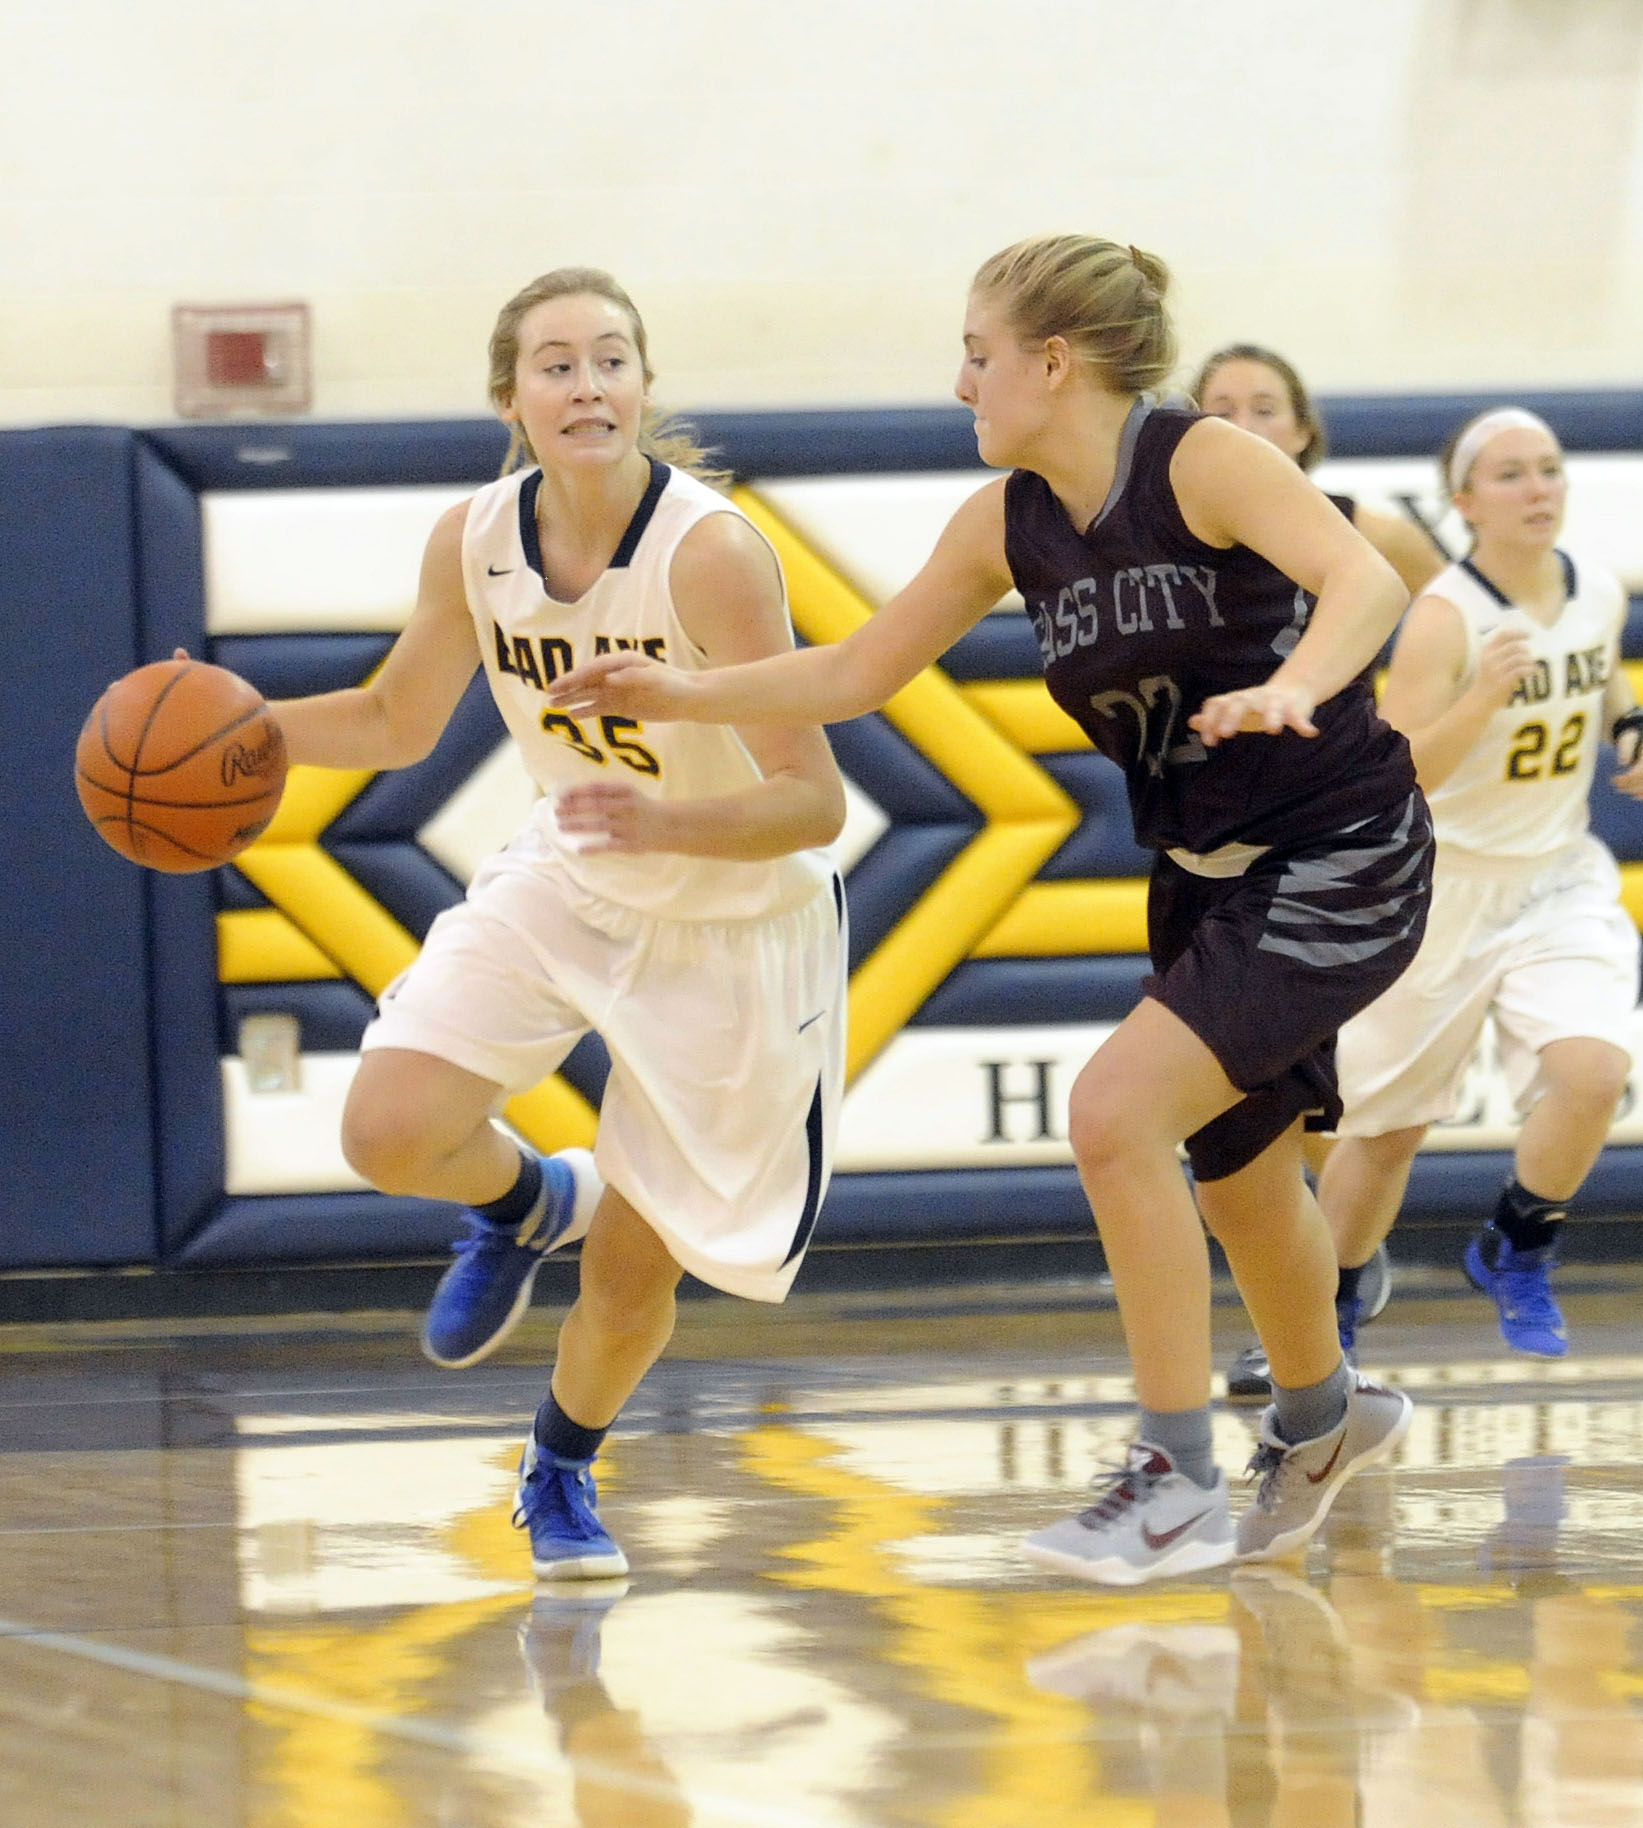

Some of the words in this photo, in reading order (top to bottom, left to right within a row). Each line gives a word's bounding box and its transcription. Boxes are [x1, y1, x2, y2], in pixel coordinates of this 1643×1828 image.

[1033, 577, 1099, 673] ASS
[1113, 563, 1226, 636] CITY
[1507, 658, 1552, 708] AD
[540, 705, 664, 782] 35
[1505, 710, 1588, 783] 22
